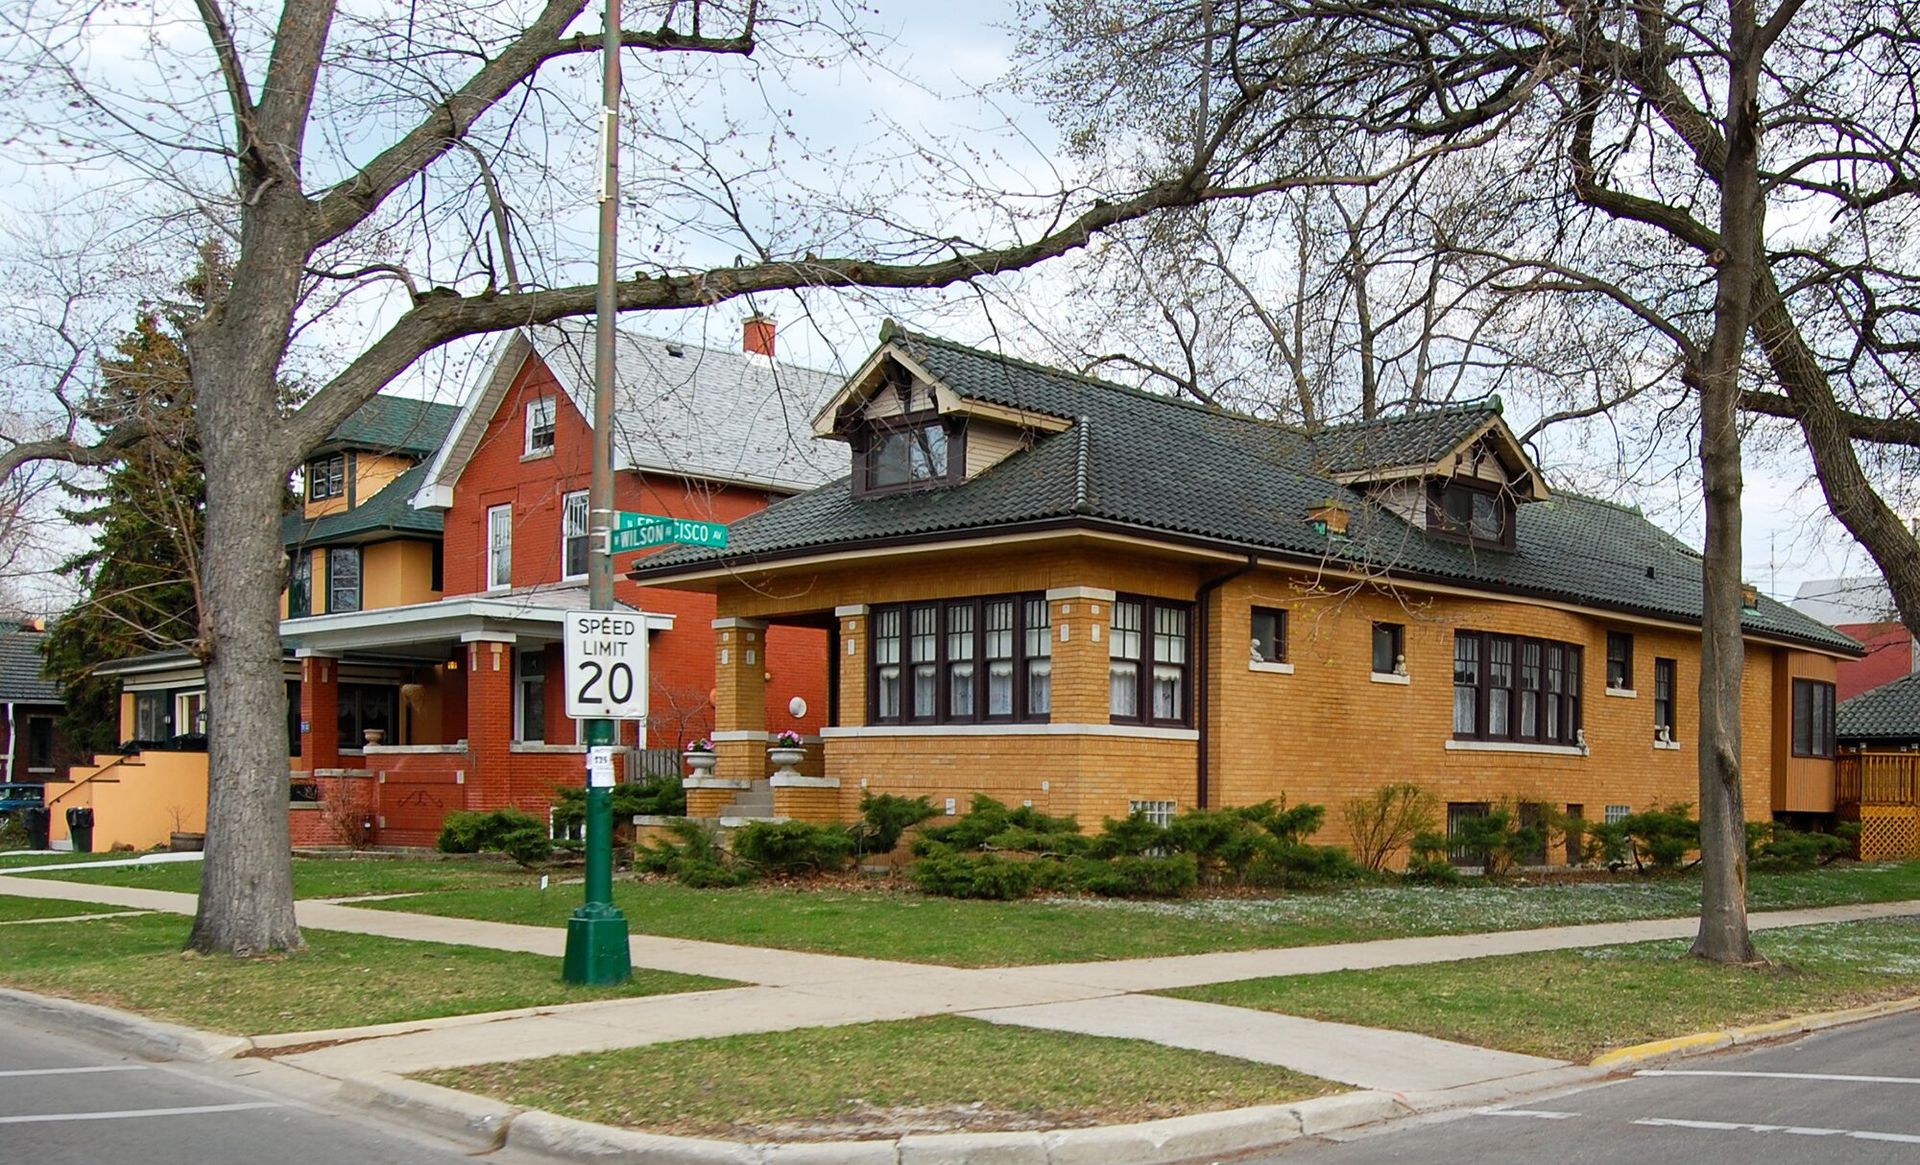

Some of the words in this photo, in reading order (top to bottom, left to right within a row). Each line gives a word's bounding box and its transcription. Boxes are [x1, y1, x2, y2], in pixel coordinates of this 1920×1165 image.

[620, 524, 664, 548] WILSON
[637, 517, 708, 541] FCISCO
[578, 618, 635, 636] SPEED
[583, 640, 628, 657] LIMIT
[578, 661, 633, 705] 20
